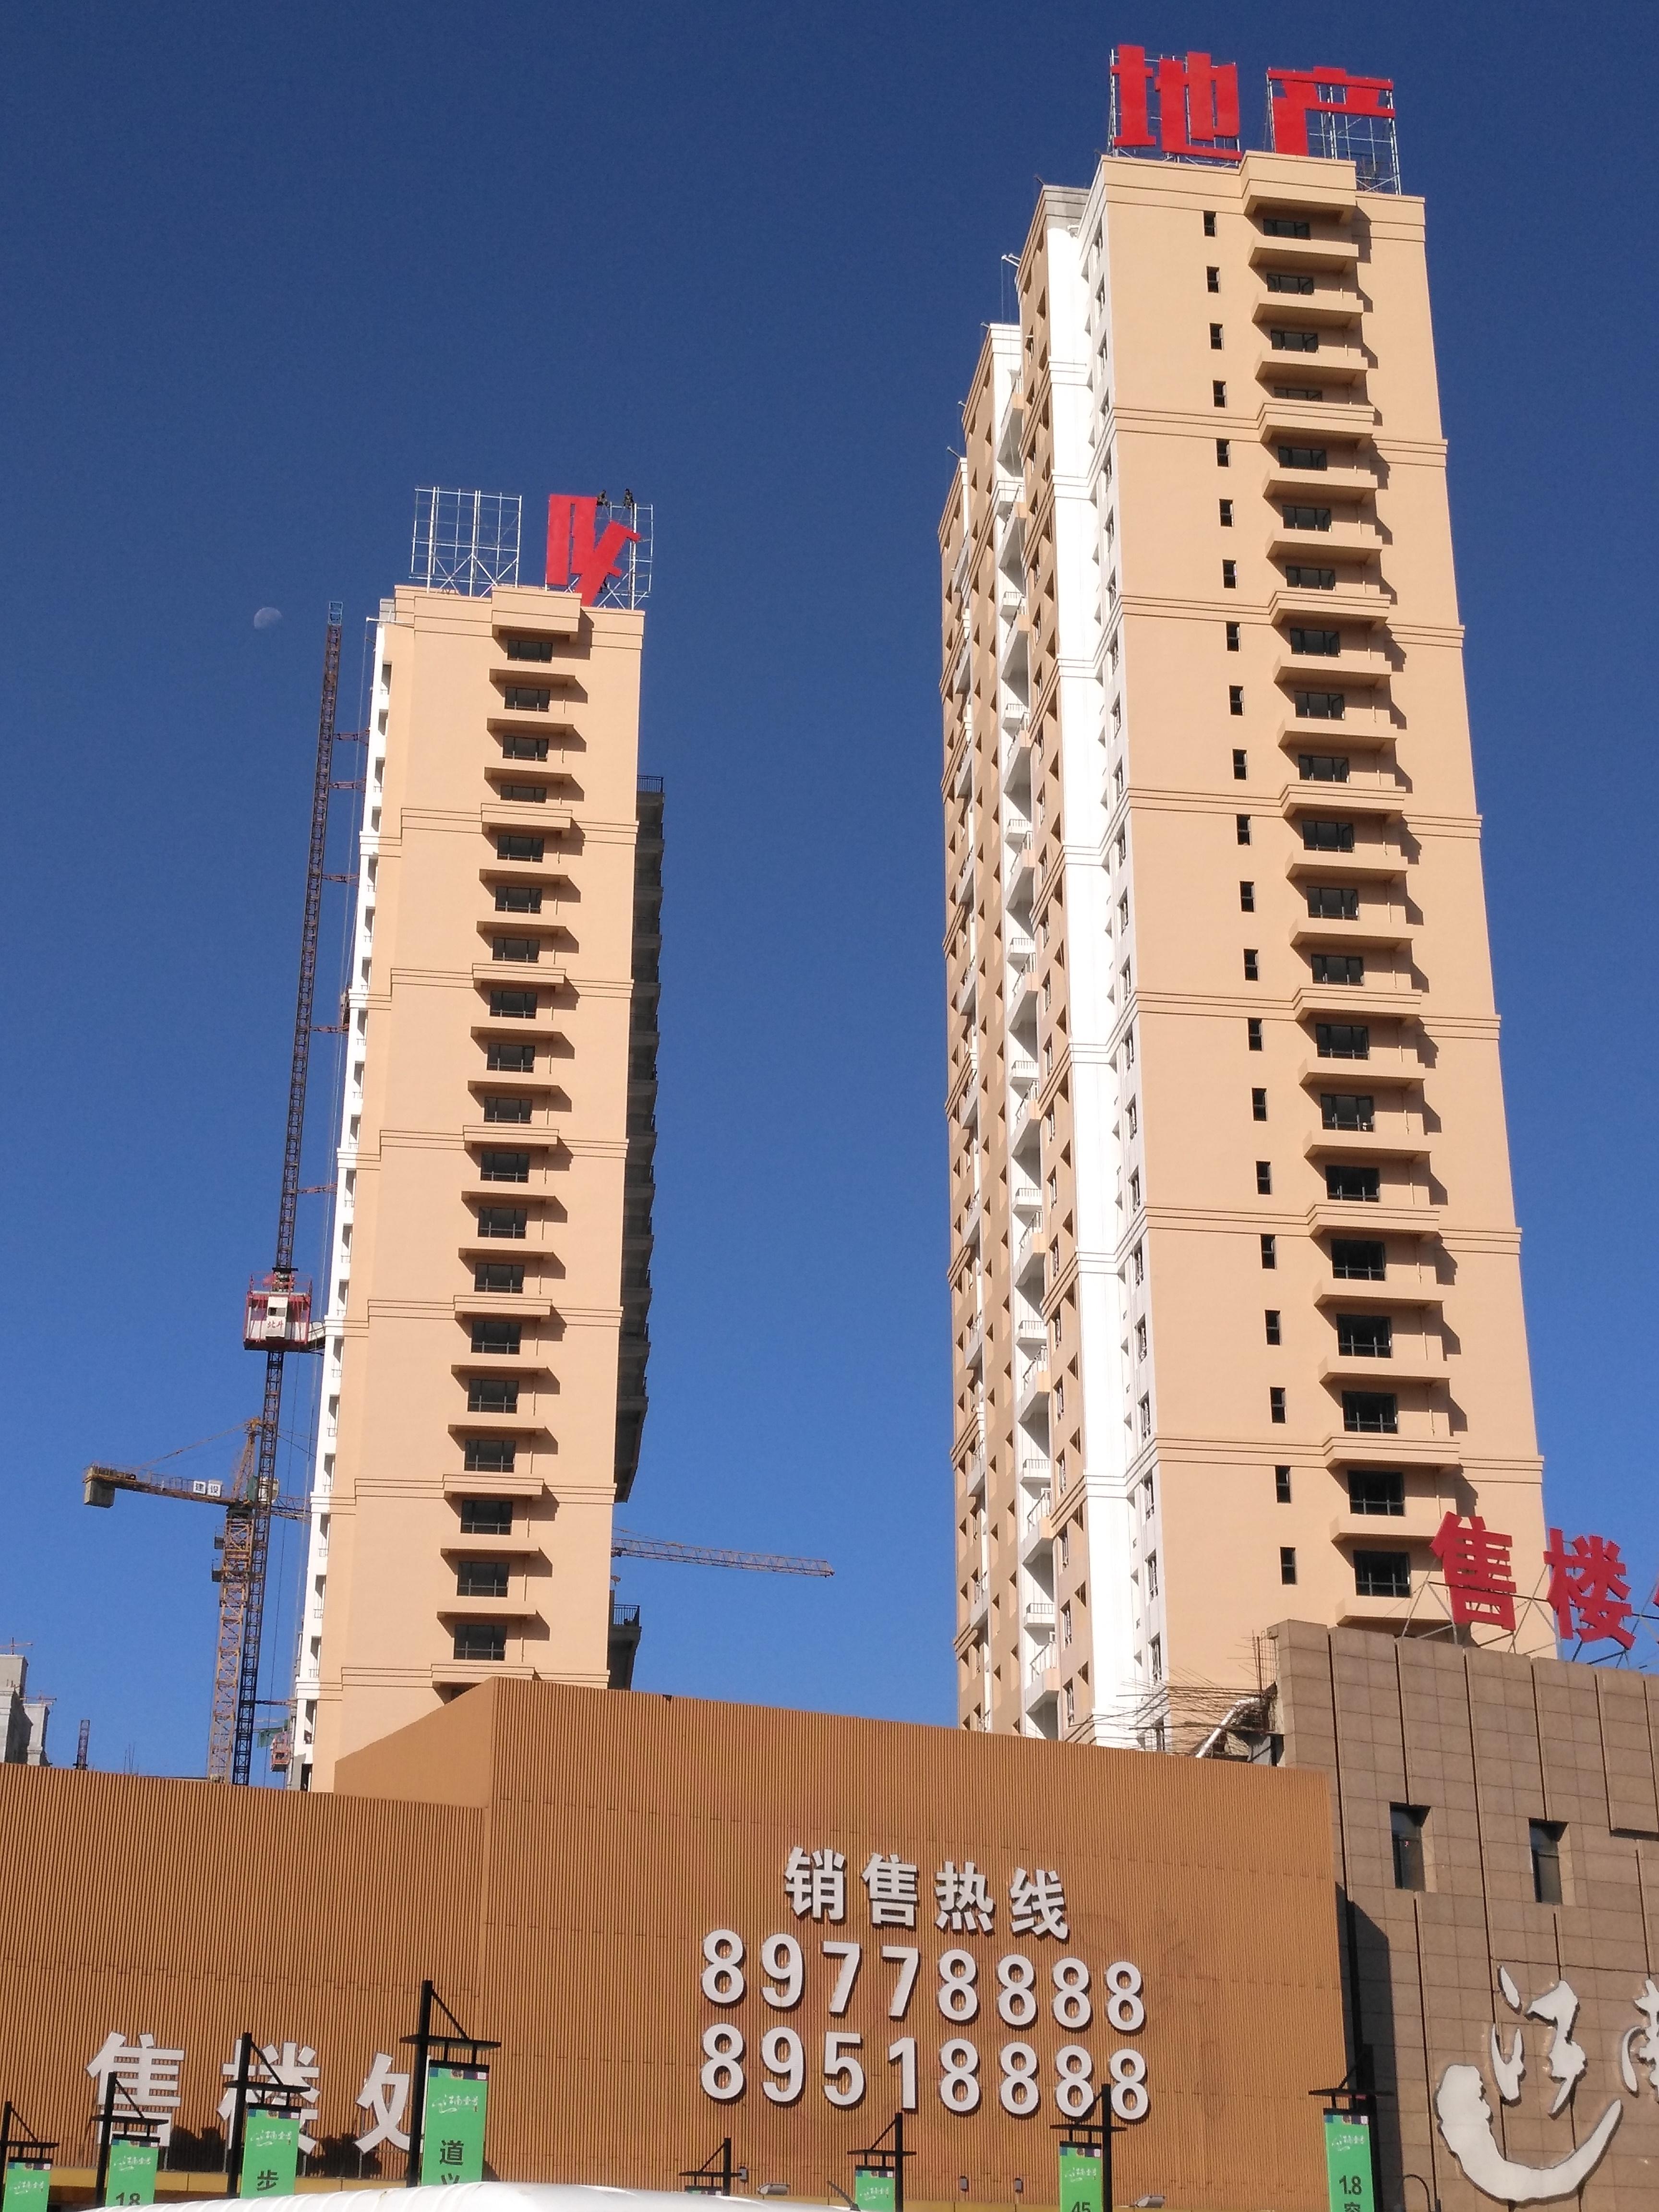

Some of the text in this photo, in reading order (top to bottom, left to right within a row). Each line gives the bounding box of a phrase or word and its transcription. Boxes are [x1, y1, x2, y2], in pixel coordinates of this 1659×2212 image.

[1111, 44, 1395, 160] 地产
[1429, 1511, 1659, 1650] 售楼
[785, 1846, 1069, 1940] 销售热线
[701, 1928, 1145, 2032] 89778888
[701, 2023, 1149, 2120] 89518888
[257, 2169, 279, 2191] 步
[1339, 2175, 1362, 2195] 1.8
